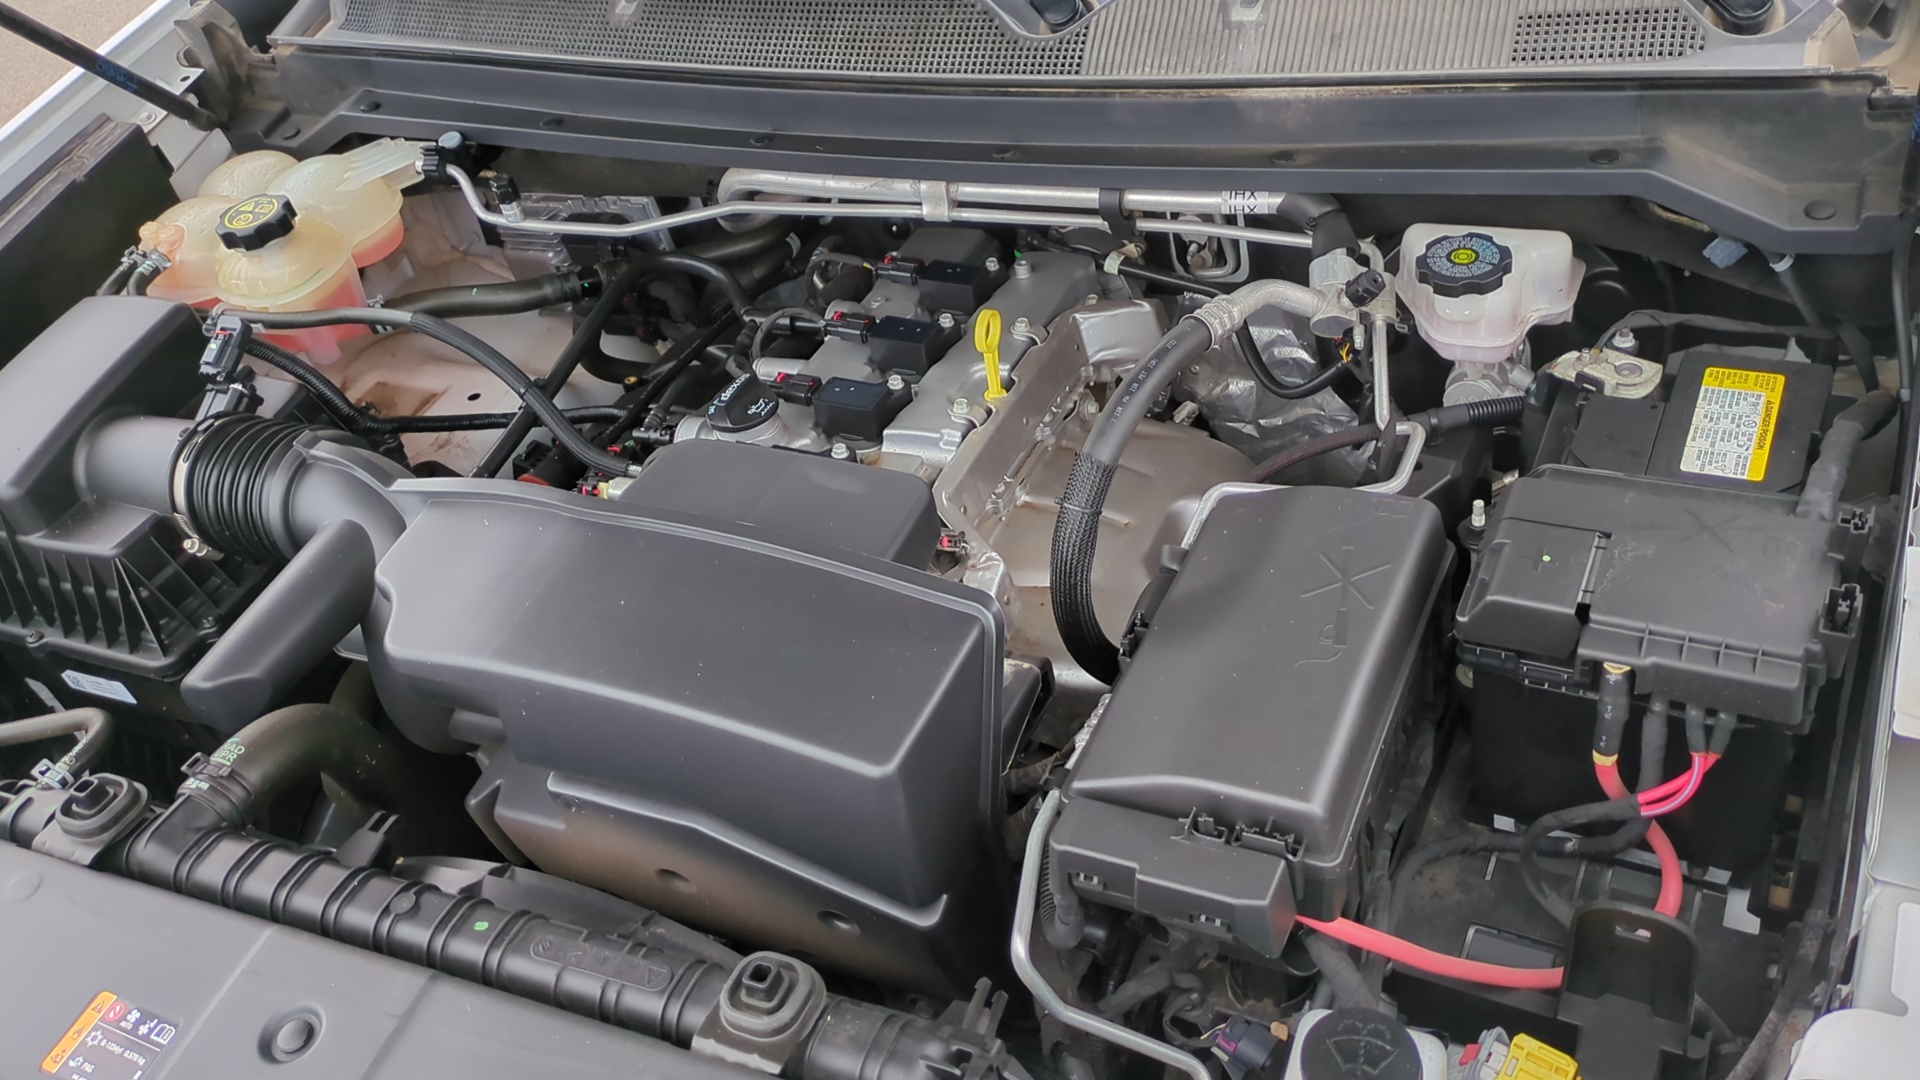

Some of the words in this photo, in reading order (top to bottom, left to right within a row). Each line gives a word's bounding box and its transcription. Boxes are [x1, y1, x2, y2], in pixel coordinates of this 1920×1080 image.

[1138, 370, 1148, 381] PET
[720, 373, 751, 401] dexos
[80, 1061, 95, 1073] PAG
